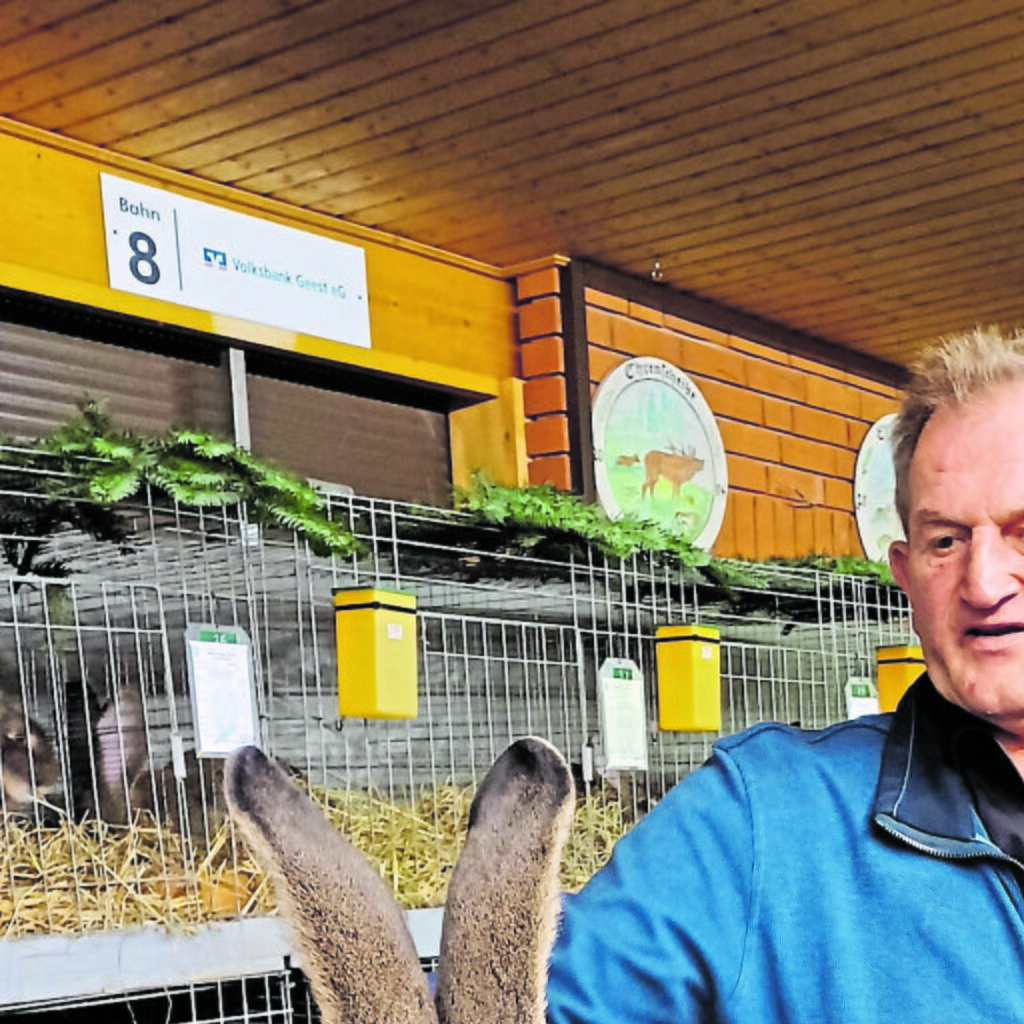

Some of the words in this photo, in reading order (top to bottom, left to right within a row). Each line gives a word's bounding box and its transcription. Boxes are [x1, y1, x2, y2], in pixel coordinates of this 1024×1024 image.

[119, 197, 161, 221] Bahn
[128, 231, 161, 285] 8
[232, 257, 291, 283] Volksbank
[295, 273, 329, 293] Geest
[331, 284, 347, 298] eG
